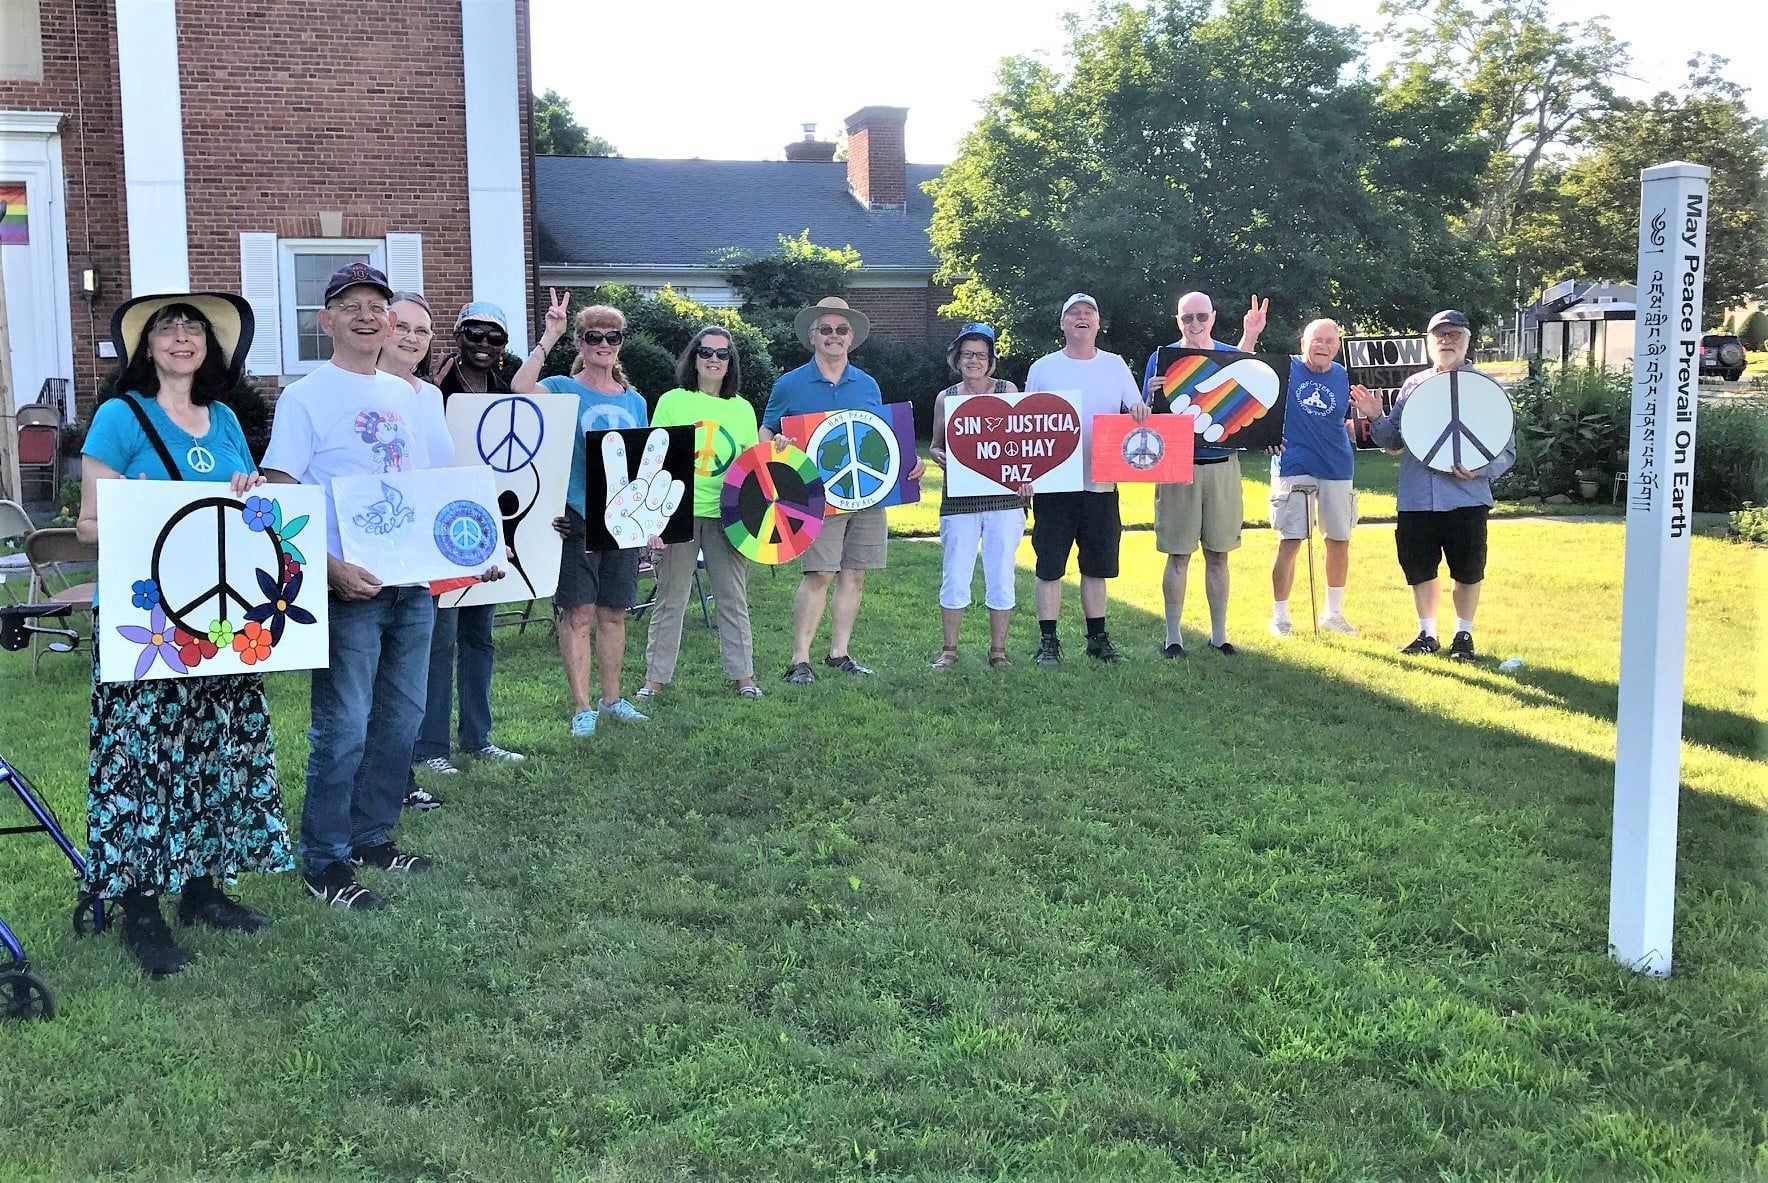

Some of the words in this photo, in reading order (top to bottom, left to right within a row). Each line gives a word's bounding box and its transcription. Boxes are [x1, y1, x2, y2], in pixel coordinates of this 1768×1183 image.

[1682, 194, 1703, 248] May
[1681, 255, 1700, 333] Peace
[1349, 340, 1423, 366] KNOW
[1676, 340, 1696, 422] Prevail
[953, 416, 981, 436] SIN
[1004, 413, 1080, 435] JUSTICIA,
[976, 441, 1001, 460] NO
[1021, 438, 1056, 458] HAY
[1674, 430, 1691, 464] On
[1001, 463, 1033, 483] PAZ
[1670, 472, 1689, 538] Earth
[353, 512, 400, 535] Peace
